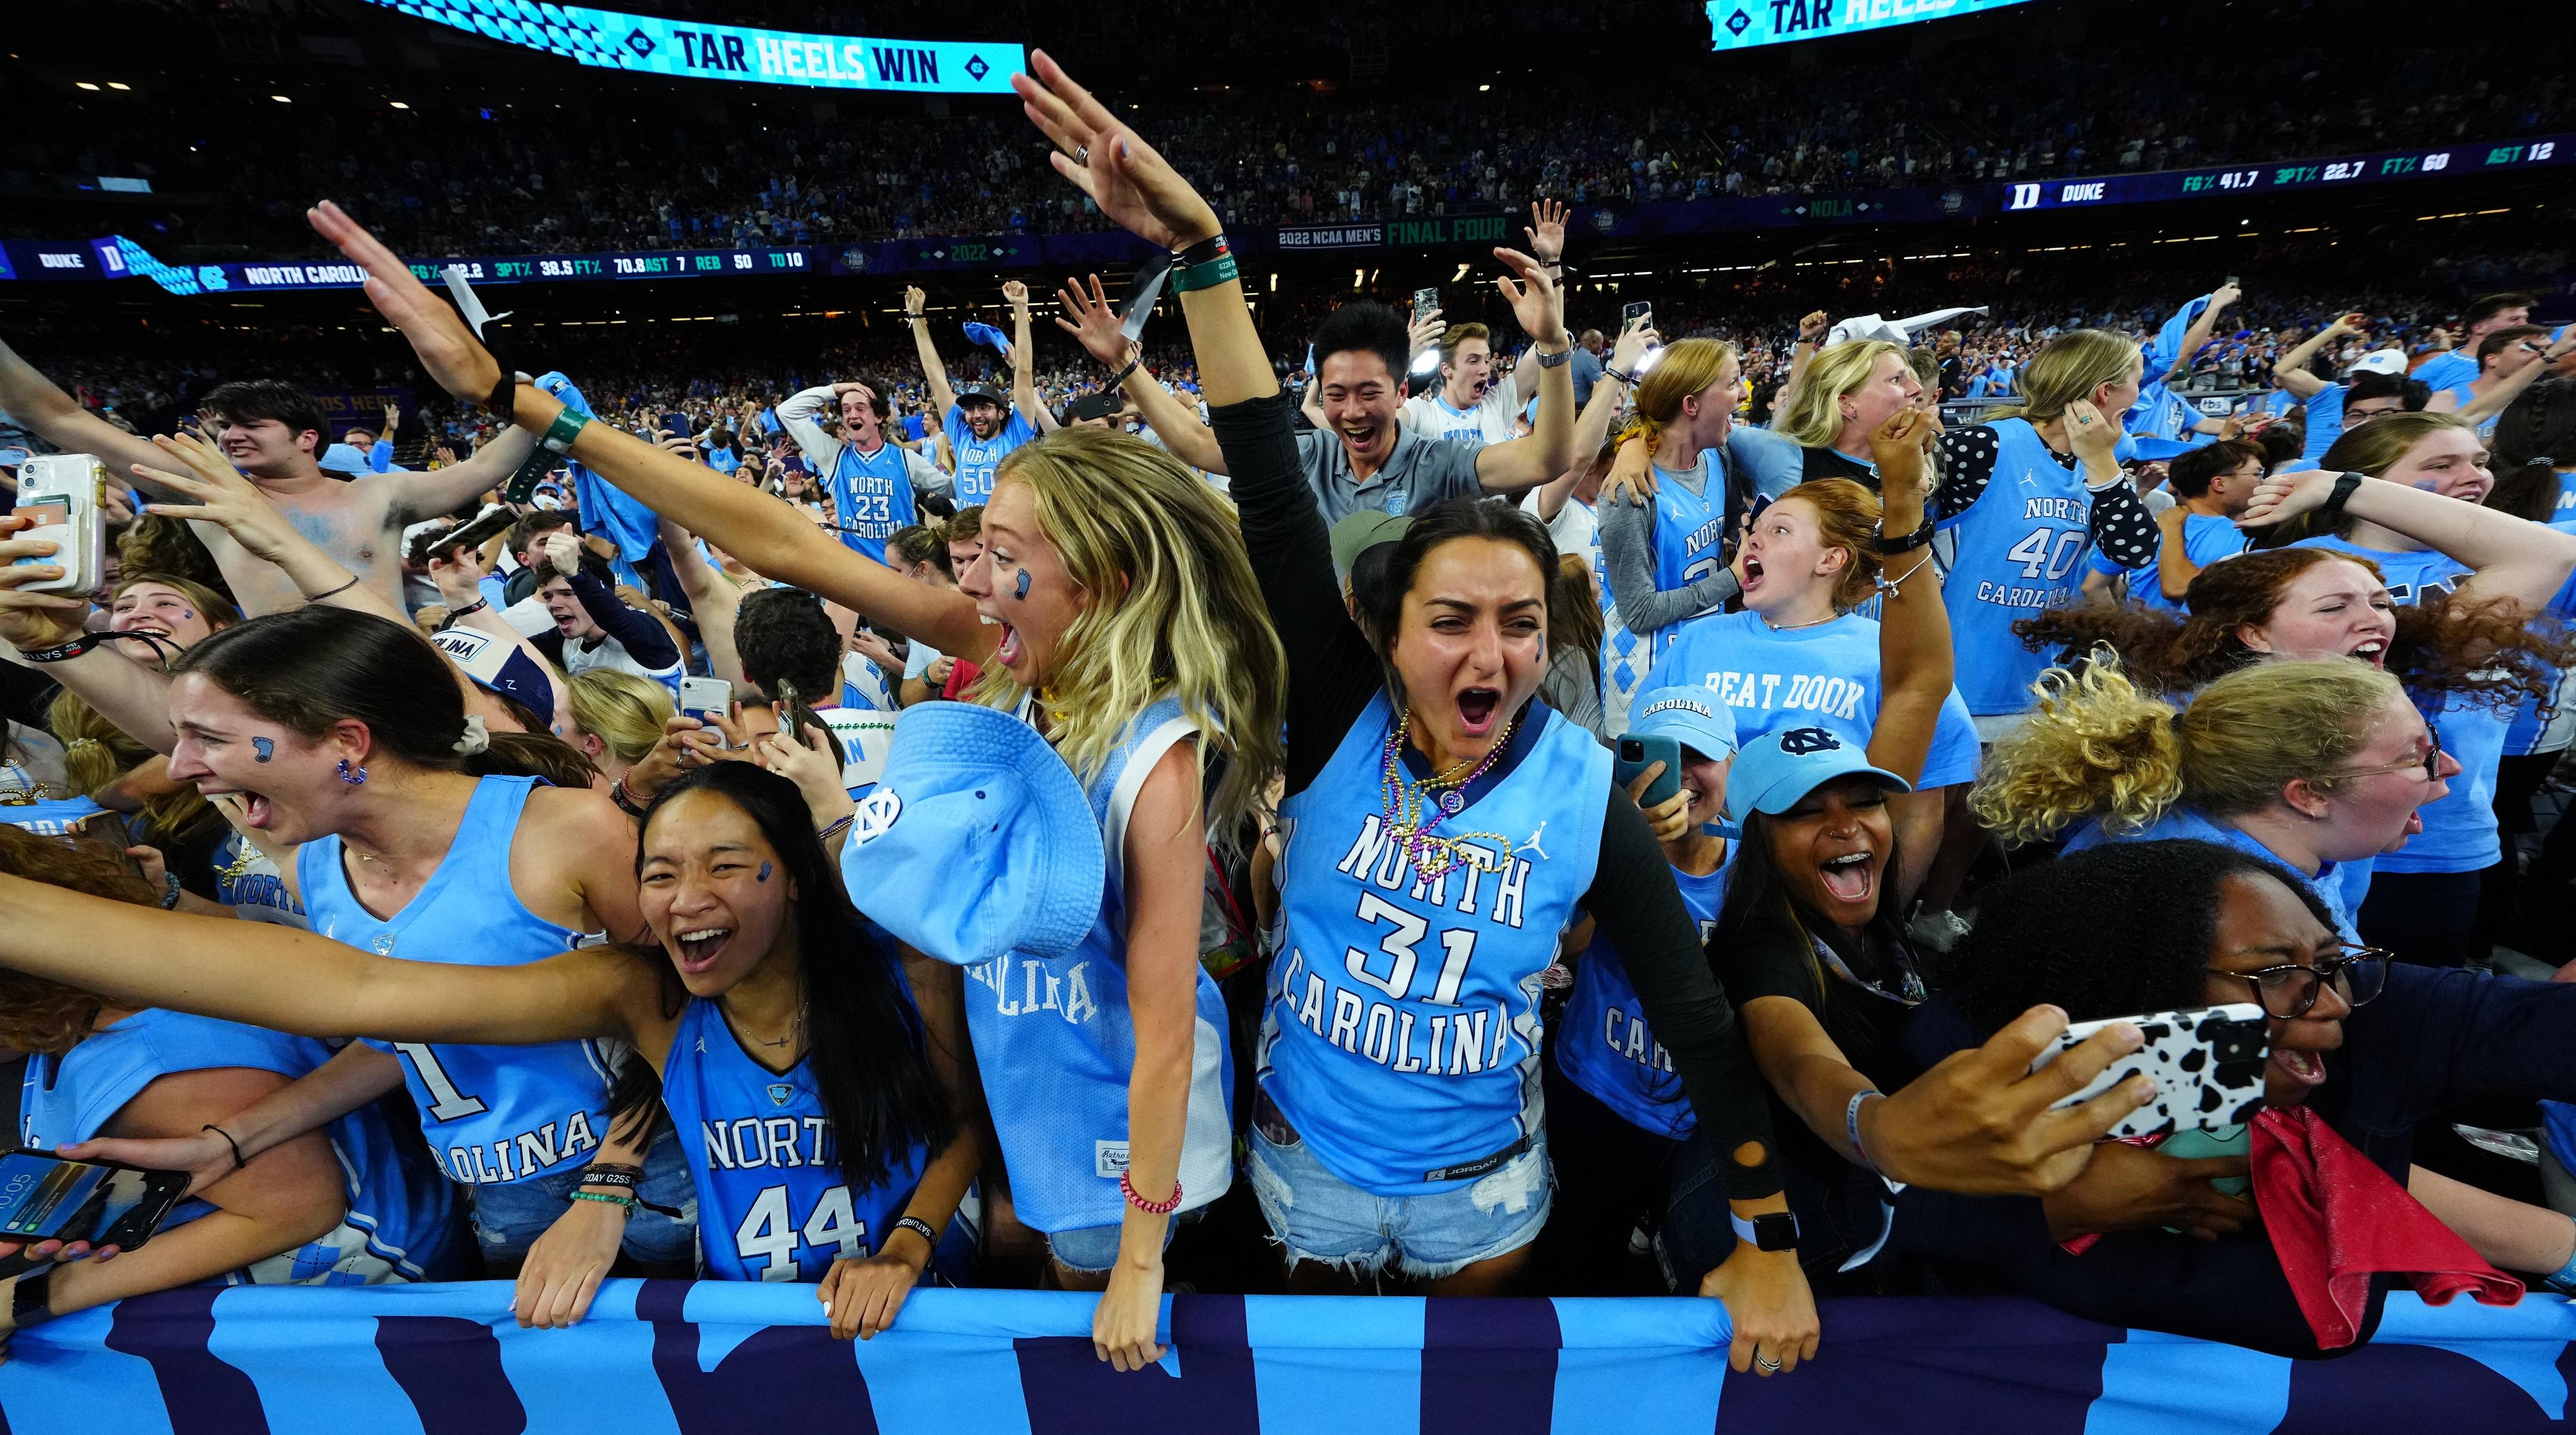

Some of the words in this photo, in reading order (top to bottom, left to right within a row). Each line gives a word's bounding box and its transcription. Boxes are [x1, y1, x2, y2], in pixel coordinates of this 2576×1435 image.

[1769, 0, 1832, 35] TAR
[674, 30, 750, 72] TAR
[755, 37, 866, 81] HEELS
[871, 47, 940, 84] WIN
[2061, 183, 2106, 203] DUKE
[2219, 171, 2259, 189] 41.7
[2273, 166, 2320, 184] 3PT%
[2322, 161, 2366, 181] 22.7
[2381, 157, 2419, 175] FT%
[2420, 153, 2451, 172] 60
[2484, 146, 2524, 165] AST
[2527, 142, 2556, 161] 12
[1810, 205, 1852, 218] NOLA
[1279, 232, 1310, 245] 2022
[1313, 230, 1343, 244] NCAA
[1346, 228, 1381, 242] MEN'S
[1387, 220, 1446, 245] FINAL
[1453, 217, 1507, 242] FOUR
[38, 253, 85, 268] DUKE
[950, 244, 987, 261] 2022
[244, 267, 305, 285] NORTH
[305, 265, 370, 283] CAROLI
[494, 262, 532, 277] 3PT%
[540, 260, 574, 276] 38.5
[614, 258, 646, 273] 70.8
[645, 257, 668, 272] AST
[676, 256, 685, 271] 7
[695, 256, 721, 270] REB
[733, 254, 753, 269] 50
[769, 253, 785, 267] TO
[786, 252, 803, 267] 10
[850, 476, 894, 496] NORTH
[962, 467, 996, 495] 50
[855, 495, 890, 522] 23
[2023, 497, 2088, 526] NORTH
[1685, 515, 1726, 559] NORT
[2006, 527, 2087, 581] 40
[1976, 580, 2069, 611] CAROLINA
[1642, 698, 1713, 719] CAROLINA
[1704, 672, 1781, 710] BEAT
[1782, 674, 1866, 721] DOOK
[1336, 814, 1534, 930] NORTH
[1345, 891, 1479, 1008] 31
[1283, 946, 1510, 1077] CAROLINA
[701, 1117, 832, 1171] NORT
[1102, 1150, 1125, 1158] Retro
[606, 1174, 631, 1184] G2SS
[1447, 1158, 1497, 1176] JORDAN
[734, 1183, 868, 1283] 44
